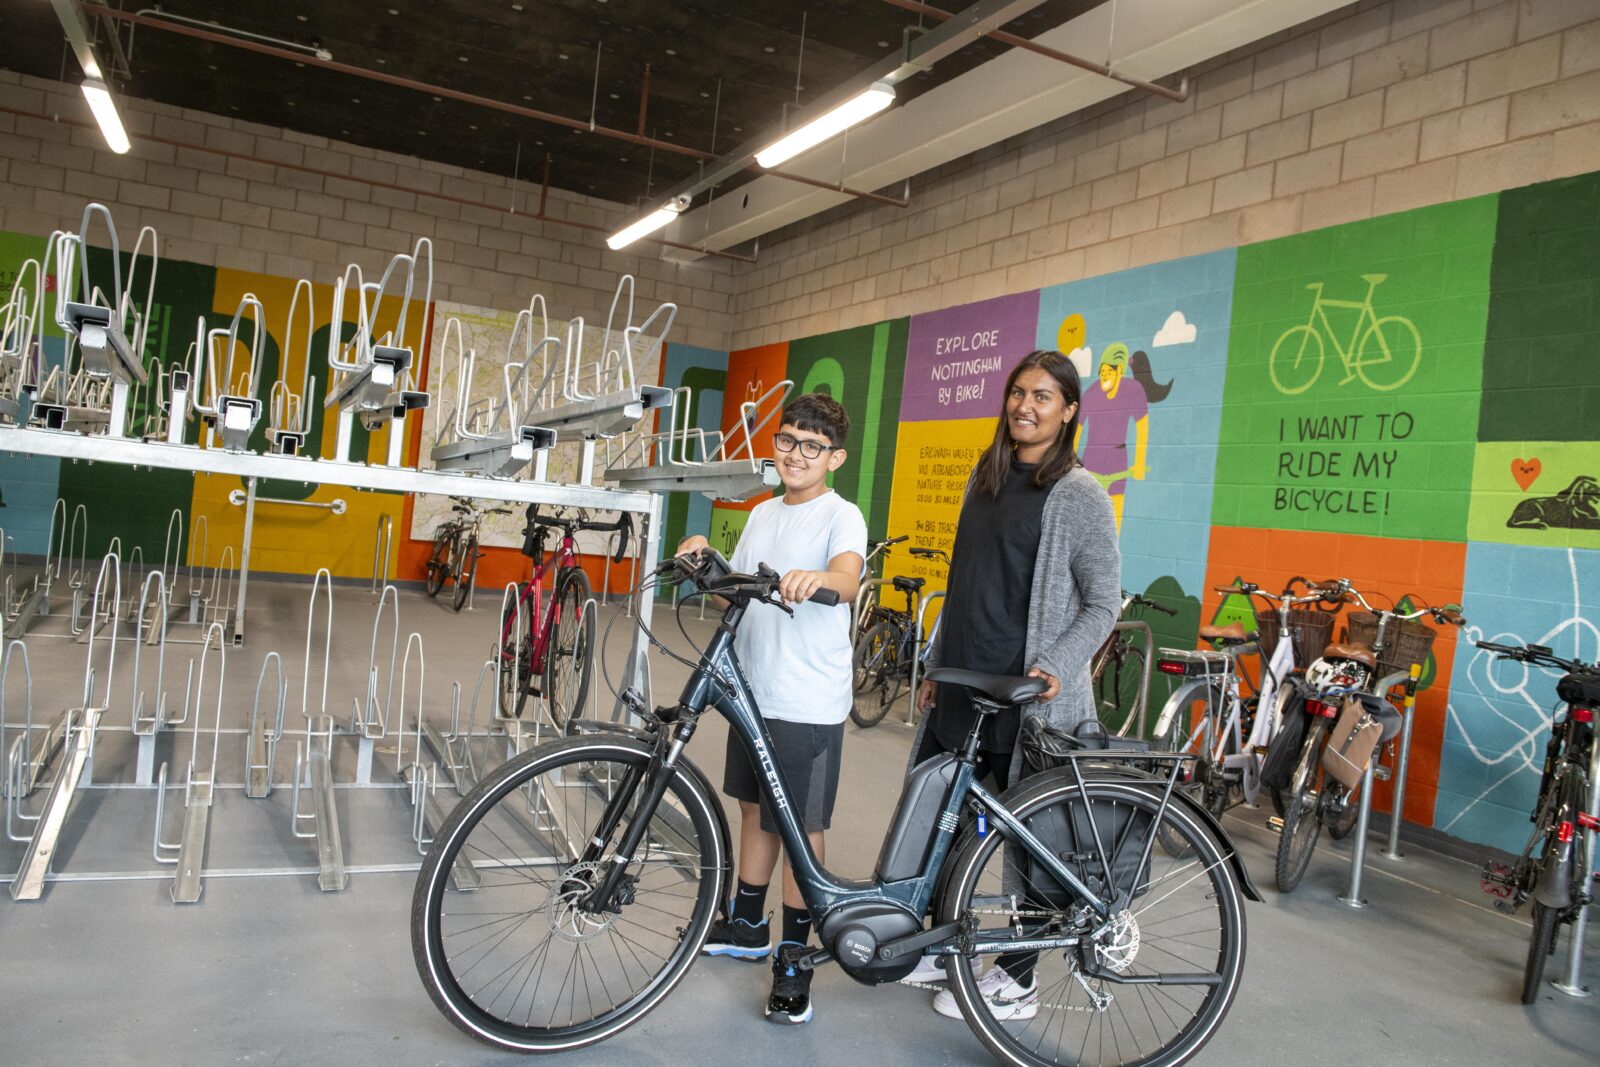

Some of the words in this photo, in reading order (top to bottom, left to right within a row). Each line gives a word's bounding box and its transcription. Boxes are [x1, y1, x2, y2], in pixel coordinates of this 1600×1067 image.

[936, 330, 999, 355] EXPLORE
[931, 356, 1002, 381] NOTTINGHAM
[1279, 418, 1285, 442] I
[1298, 415, 1364, 442] WANT
[1376, 411, 1414, 440] TO
[1278, 452, 1342, 478] RIDE
[1353, 450, 1397, 478] MY
[1274, 487, 1390, 515] BICYCLE!
[925, 520, 935, 532] BIG
[915, 536, 935, 547] TRENT
[938, 538, 954, 549] BRID
[754, 738, 787, 808] RALEIGH
